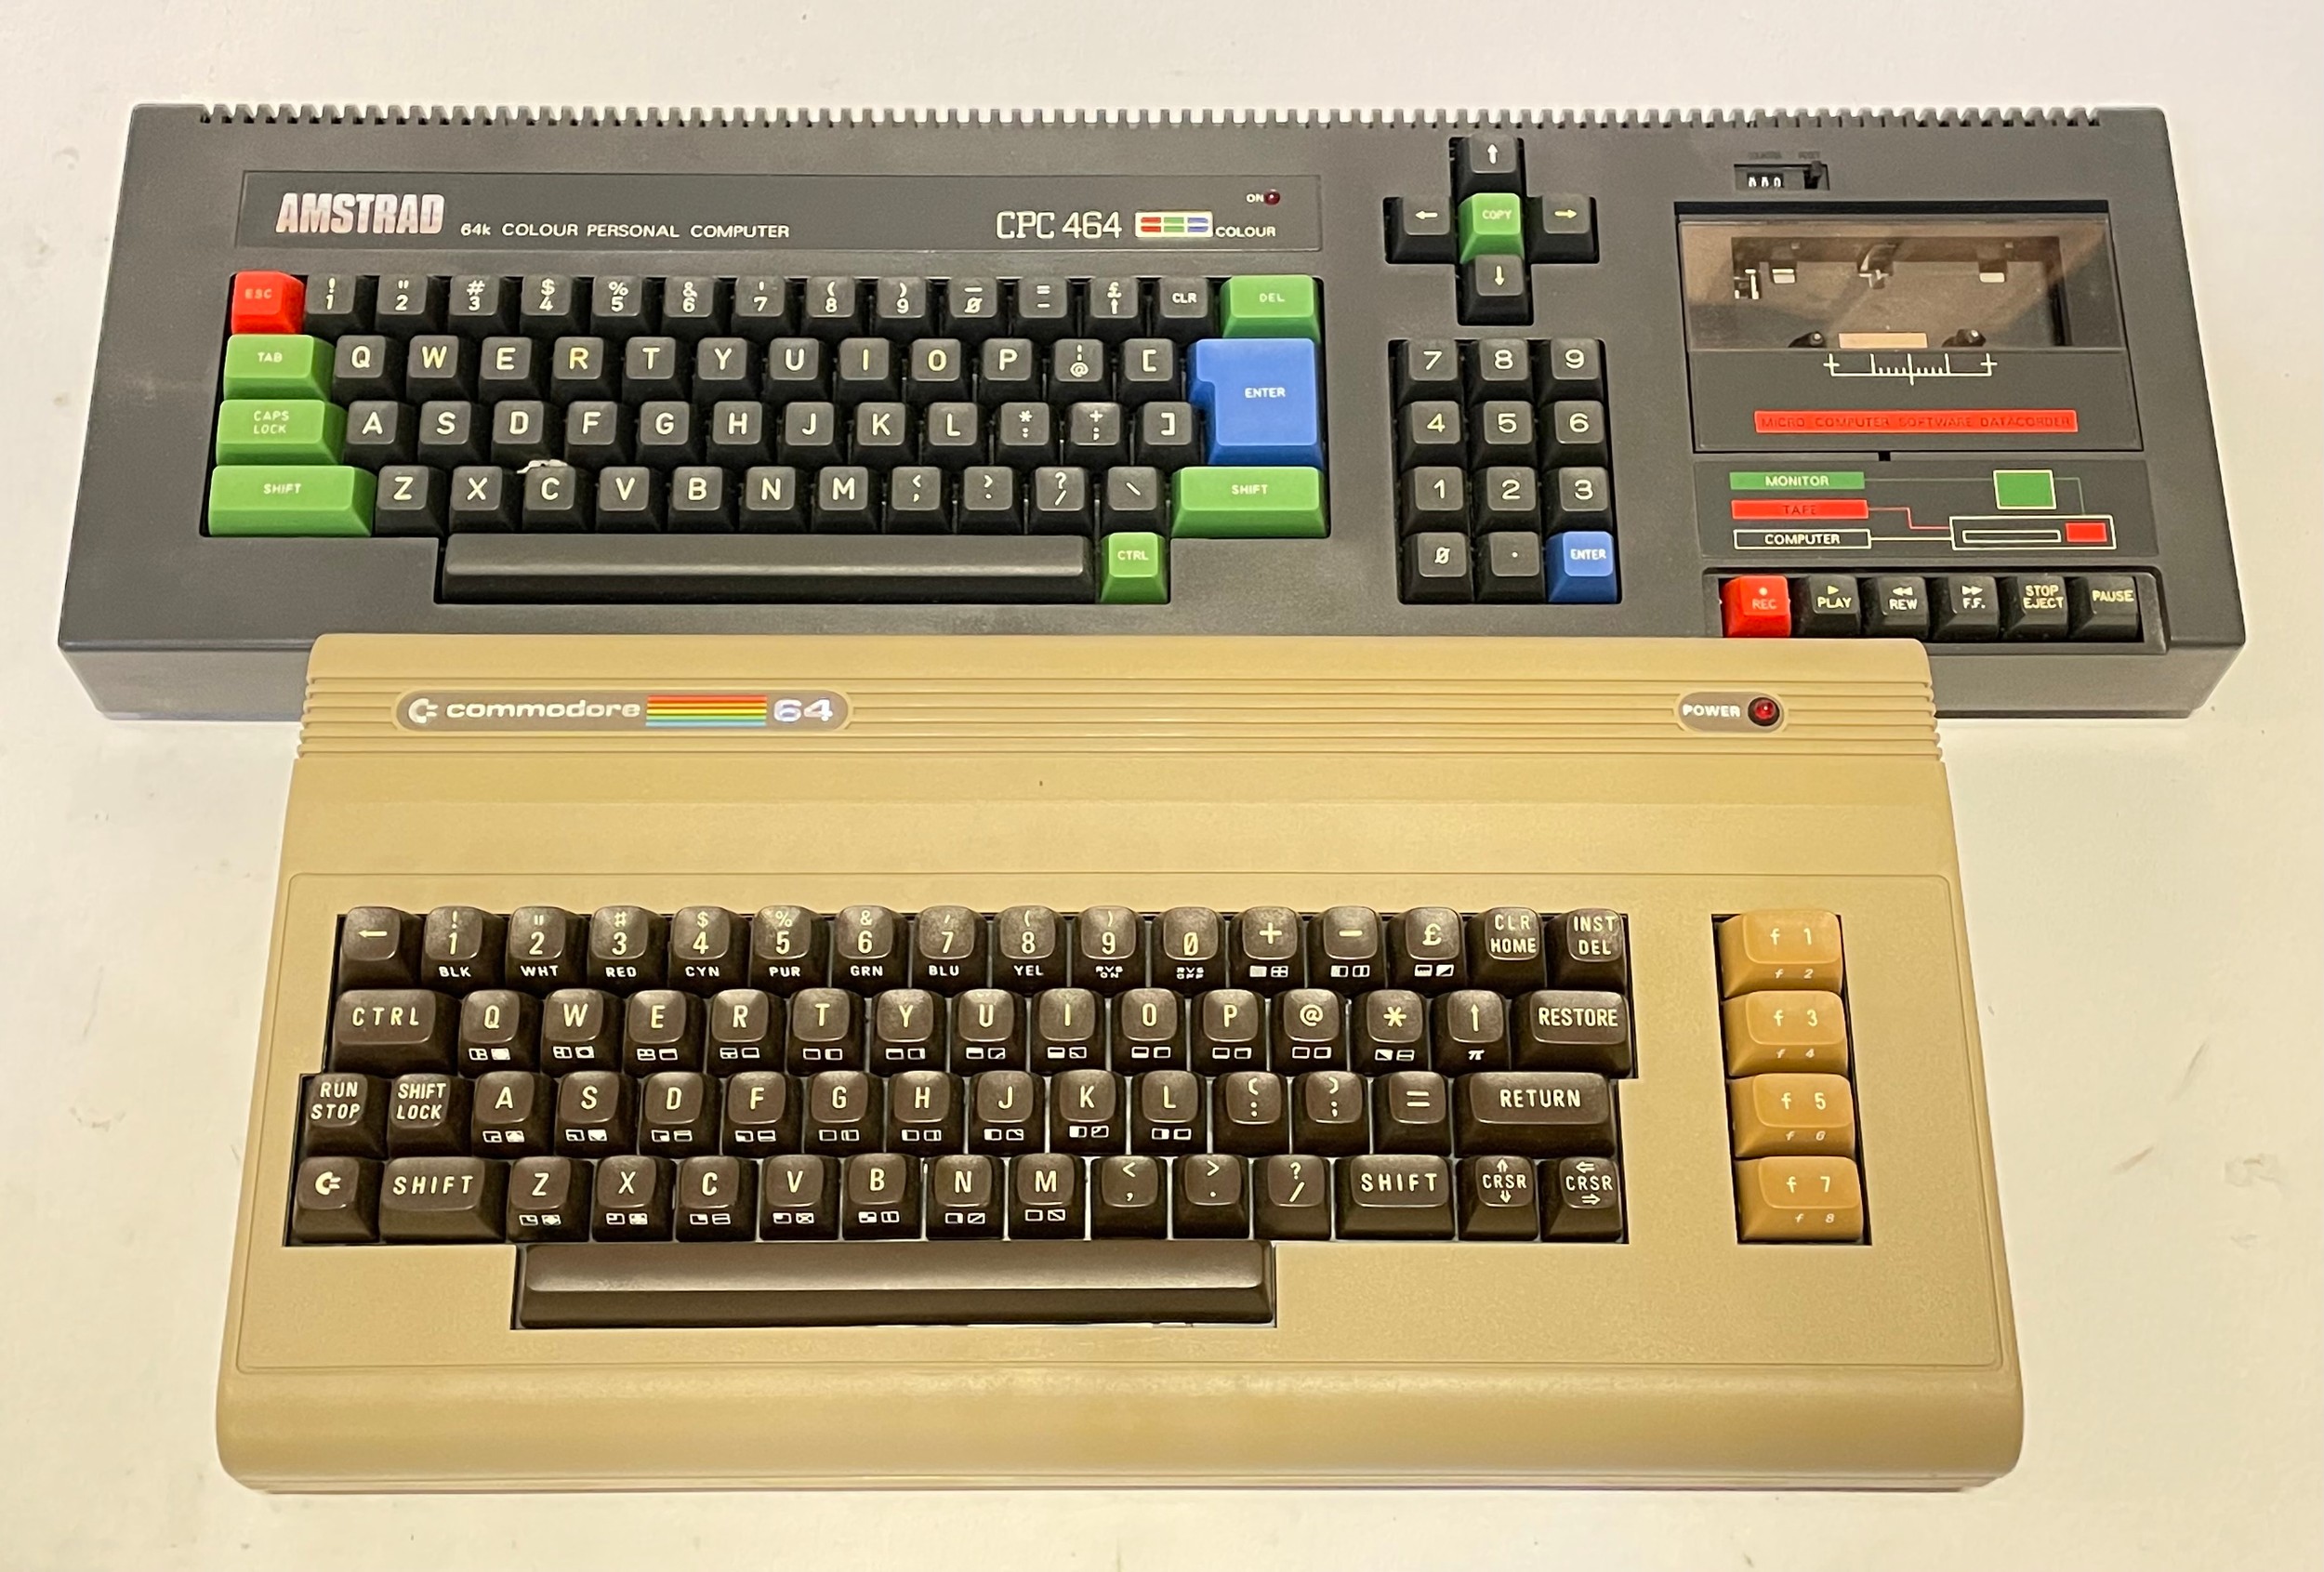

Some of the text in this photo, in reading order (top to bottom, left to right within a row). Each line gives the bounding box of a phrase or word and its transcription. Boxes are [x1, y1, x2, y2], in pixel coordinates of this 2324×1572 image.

[1247, 193, 1263, 203] ON
[275, 192, 445, 234] AMSTRAD
[1482, 209, 1512, 220] COPY
[460, 223, 790, 238] 64k COLOUR PERSONAL COMPUTER
[997, 210, 1123, 239] CPC 464
[1215, 226, 1276, 238] COLOUR
[244, 288, 272, 299] ESC
[395, 294, 409, 311] 2
[469, 295, 481, 311] 3
[539, 296, 554, 311] 4
[611, 296, 624, 312] 5
[683, 296, 695, 312] 6
[753, 296, 768, 312] 7
[1171, 292, 1197, 304] CLR
[1259, 292, 1286, 303] DEL
[825, 297, 838, 313] 8
[896, 297, 909, 314] 9
[257, 351, 283, 363] TAB
[351, 345, 371, 369] Q
[421, 346, 447, 369] W
[496, 347, 516, 370] E
[569, 347, 589, 370] R
[641, 347, 661, 370] T
[714, 348, 733, 371] Y
[786, 348, 805, 371] U
[928, 349, 947, 372] O
[998, 348, 1018, 371] P
[1423, 350, 1443, 371] 7
[1494, 349, 1513, 370] 8
[1565, 349, 1585, 369] 9
[1244, 387, 1286, 399] ENTER
[253, 410, 290, 422] CAPS
[362, 411, 383, 435] A
[436, 411, 456, 435] S
[509, 411, 529, 435] D
[655, 412, 674, 435] G
[728, 412, 748, 435] H
[872, 413, 891, 436] K
[946, 413, 961, 437] L
[1427, 413, 1446, 433] 4
[1498, 413, 1517, 433] 5
[1569, 413, 1590, 433] 6
[1761, 416, 2070, 428] MICRO COMPUTER SOFTWARE DATACORDER
[253, 423, 286, 435] LOCK
[263, 482, 302, 495] SHIFT
[393, 476, 414, 500] Z
[467, 477, 488, 501] X
[541, 477, 561, 501] C
[688, 477, 707, 501] B
[761, 477, 781, 501] N
[832, 477, 855, 501] M
[1231, 483, 1268, 495] SHIFT
[1501, 479, 1521, 500] 2
[1574, 479, 1593, 500] 3
[1764, 475, 1829, 487] MONITOR
[1764, 533, 1841, 546] COMPUTER
[1116, 549, 1149, 561] CTRL
[1570, 548, 1607, 561] ENTER
[2025, 584, 2059, 597] STOP
[2092, 589, 2135, 602] PAUSE
[1751, 598, 1777, 610] REC
[1816, 596, 1852, 609] PLAY
[1889, 598, 1918, 611] REW
[2023, 596, 2065, 609] EJECT
[446, 699, 834, 722] commodore 64
[1682, 704, 1741, 718] POWER
[1495, 914, 1531, 931] CLR
[1573, 917, 1615, 932] INST
[529, 931, 545, 955] 2
[612, 931, 627, 956] 3
[693, 931, 709, 955] 4
[775, 930, 790, 955] 5
[857, 930, 873, 954] 6
[941, 931, 954, 954] 7
[1021, 931, 1036, 955] 8
[1102, 931, 1116, 956] 9
[1490, 937, 1537, 954] HOME
[1578, 939, 1612, 956] DEL
[438, 966, 471, 978] BLK
[520, 965, 559, 977] WHT
[605, 966, 637, 978] RED
[684, 966, 720, 977] CYN
[769, 966, 800, 978] PUR
[850, 965, 883, 977] GRN
[929, 964, 959, 977] BLU
[1013, 964, 1044, 976] YEL
[352, 1006, 419, 1026] CTRL
[483, 1004, 500, 1029] Q
[563, 1003, 588, 1027] W
[651, 1004, 666, 1029] E
[733, 1004, 748, 1028] R
[814, 1002, 831, 1026] T
[899, 1005, 914, 1027] Y
[979, 1003, 995, 1028] U
[1142, 1002, 1157, 1026] O
[1223, 1004, 1238, 1028] P
[1538, 1007, 1618, 1027] RESTORE
[320, 1081, 358, 1099] RUN
[397, 1082, 447, 1100] SHIFT
[495, 1086, 513, 1109] A
[581, 1085, 598, 1110] S
[666, 1087, 682, 1110] D
[750, 1087, 765, 1110] F
[832, 1085, 847, 1109] G
[915, 1086, 931, 1109] H
[1080, 1085, 1095, 1108] K
[1163, 1085, 1177, 1109] L
[1499, 1089, 1581, 1108] RETURN
[310, 1103, 361, 1120] STOP
[396, 1103, 442, 1120] LOCK
[392, 1175, 474, 1196] SHIFT
[532, 1172, 549, 1196] Z
[618, 1170, 637, 1195] X
[702, 1171, 719, 1196] C
[869, 1168, 885, 1192] B
[955, 1170, 972, 1194] N
[1035, 1169, 1057, 1193] M
[1361, 1172, 1437, 1193] SHIFT
[1482, 1174, 1527, 1189] CRSR
[1565, 1174, 1614, 1191] CRSR
